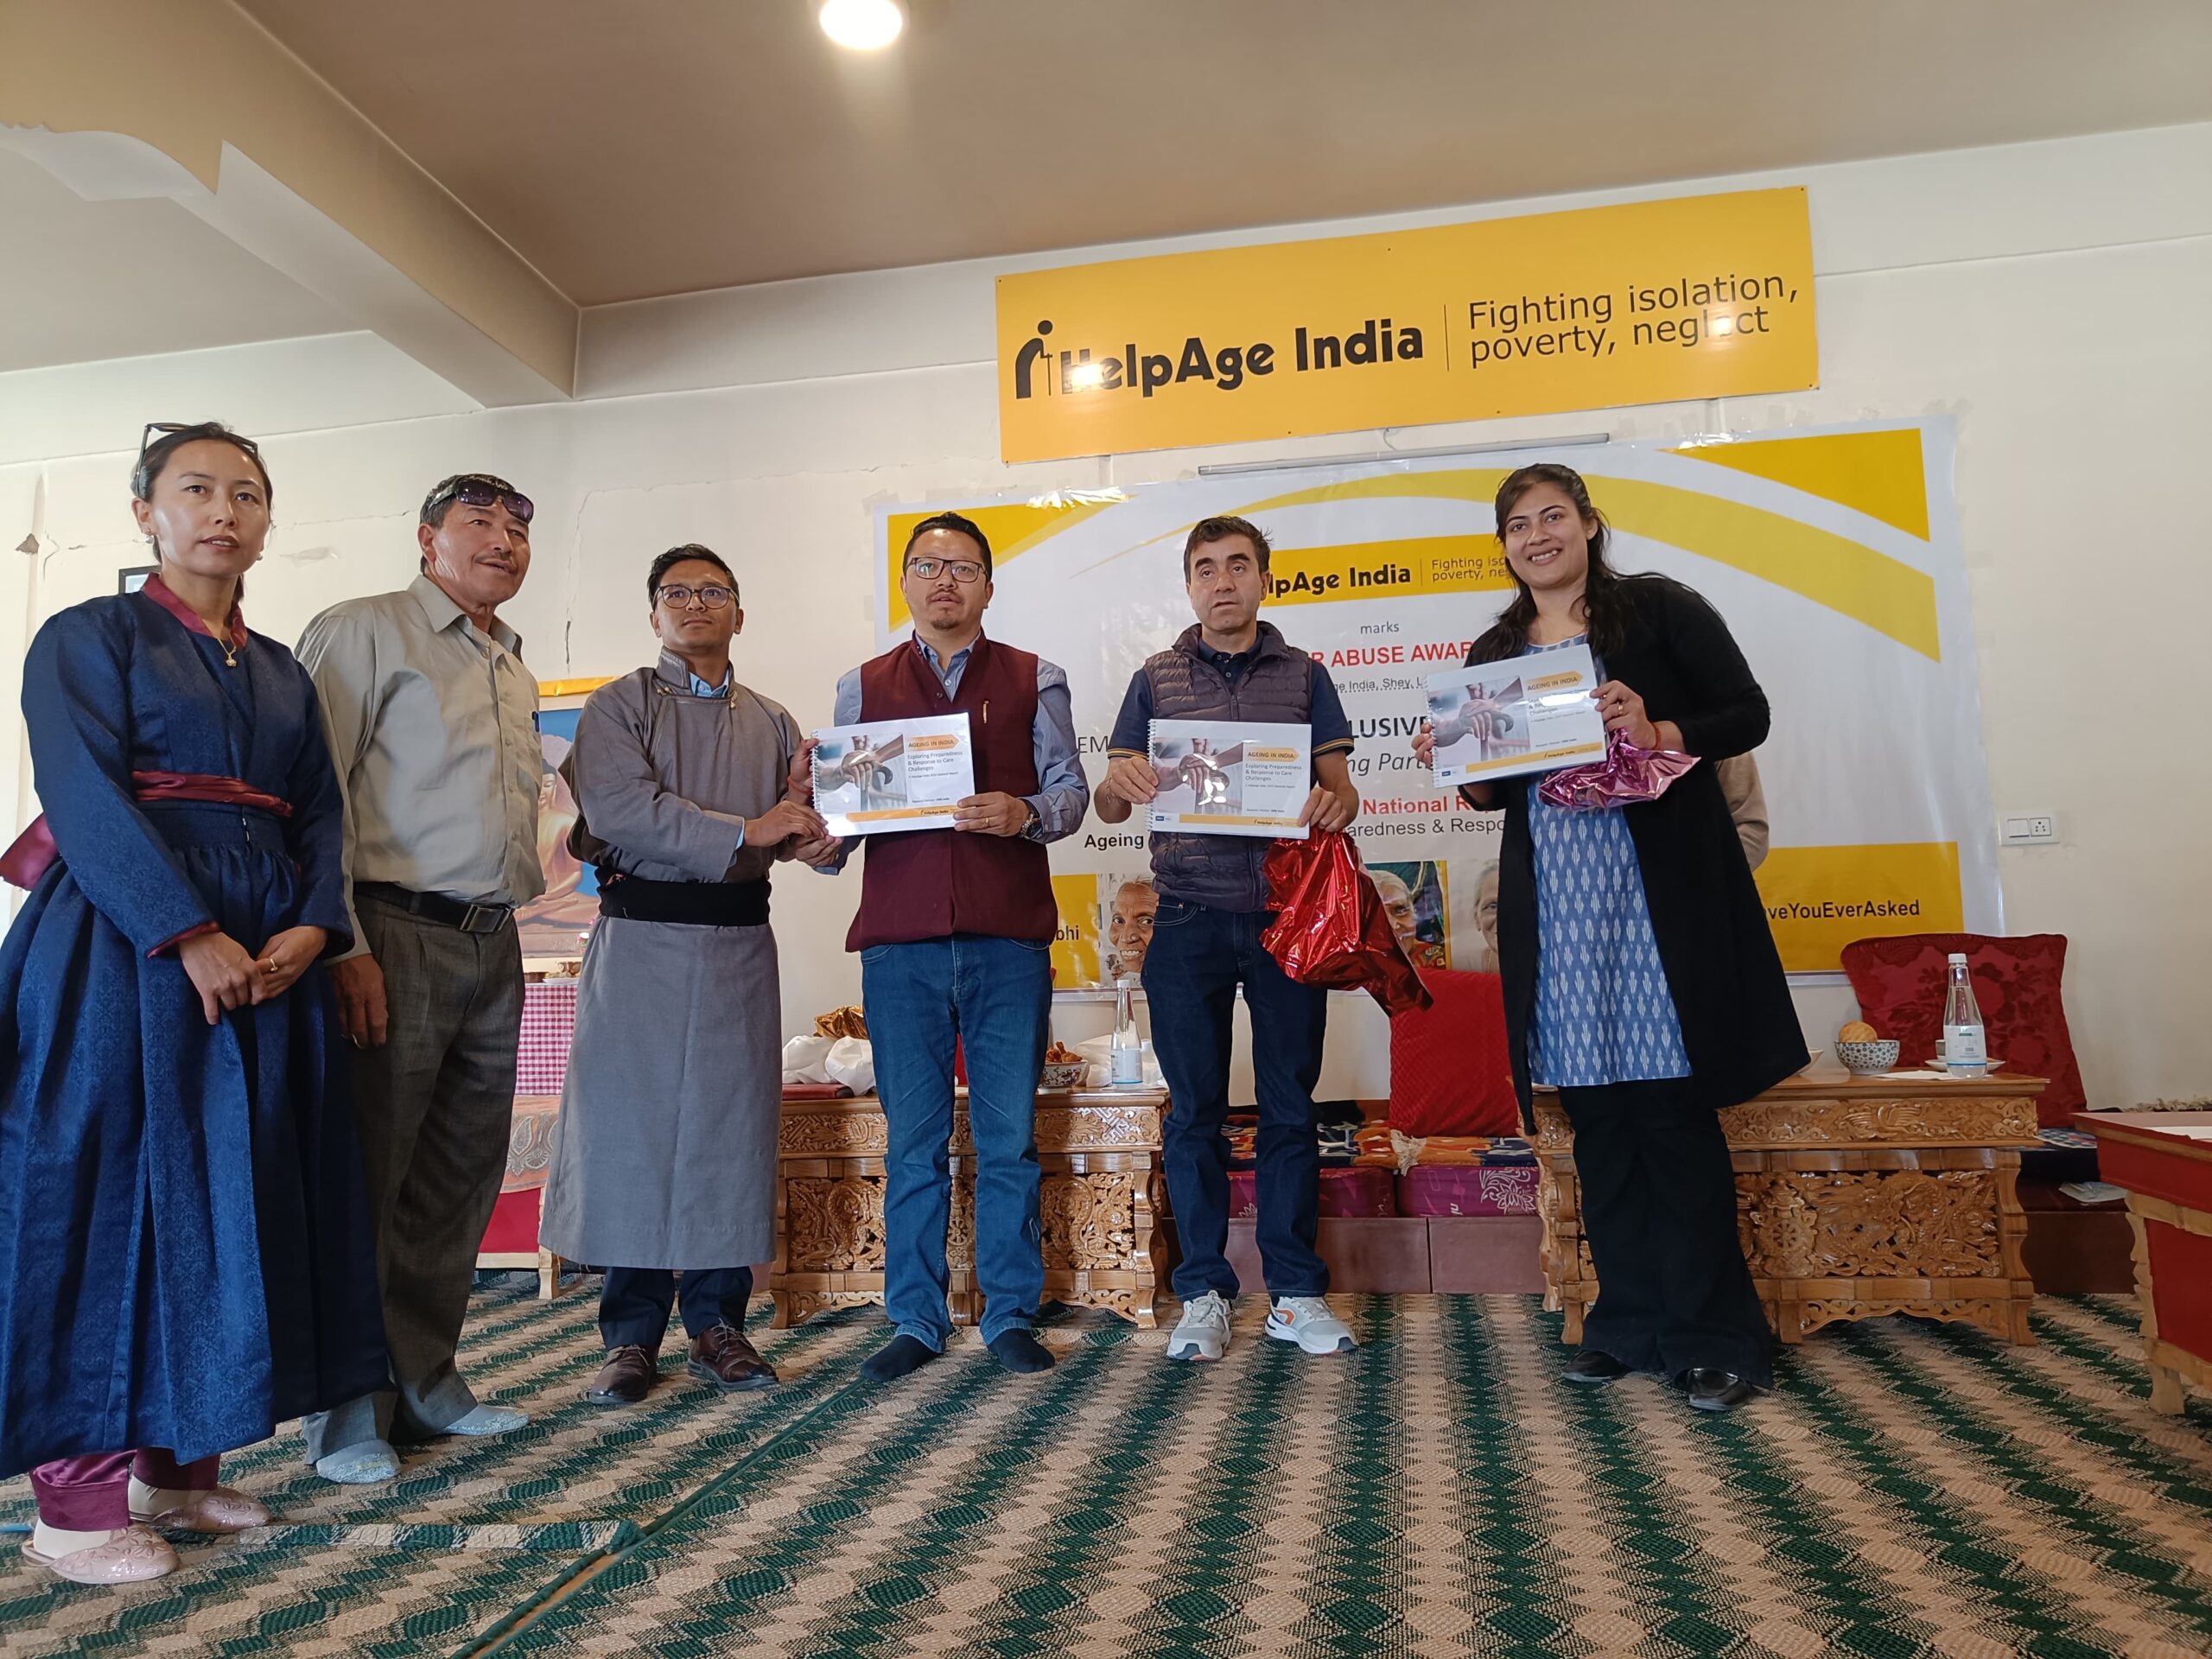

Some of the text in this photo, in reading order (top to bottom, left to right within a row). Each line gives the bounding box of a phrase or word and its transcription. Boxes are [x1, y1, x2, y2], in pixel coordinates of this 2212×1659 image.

[1469, 274, 1798, 333] Fighting isolation,
[1059, 318, 1423, 397] HelpAge India
[1471, 326, 1616, 368] poverty,
[1432, 557, 1483, 571] Fighting
[1350, 564, 1411, 588] India
[1433, 569, 1484, 583] poverty,
[1360, 621, 1400, 634] marks
[1331, 646, 1404, 667] ABUSE
[1350, 679, 1378, 691] India,
[1363, 796, 1447, 815] National
[1084, 833, 1144, 851] Ageing
[1432, 819, 1444, 833] &
